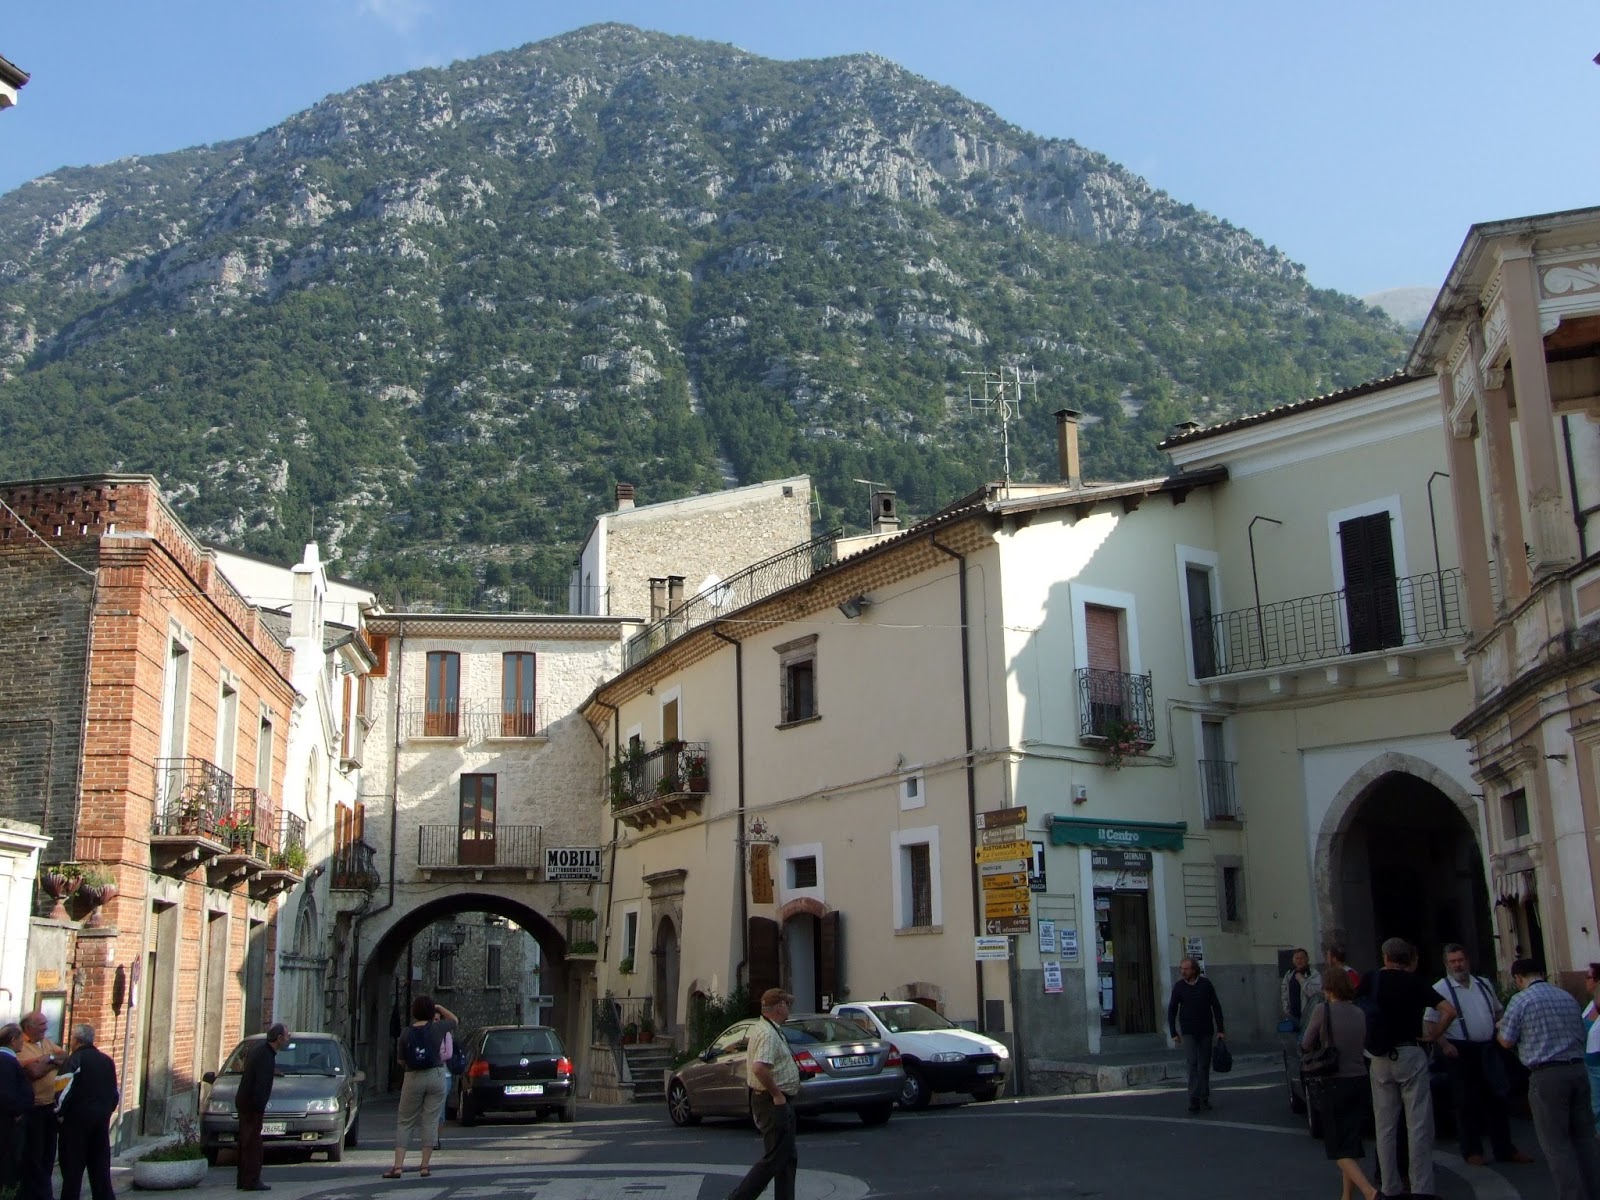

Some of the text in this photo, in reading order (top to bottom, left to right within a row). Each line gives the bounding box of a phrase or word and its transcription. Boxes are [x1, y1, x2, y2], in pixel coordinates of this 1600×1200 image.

[1098, 828, 1139, 841] il Centro
[548, 850, 600, 866] MOBILI
